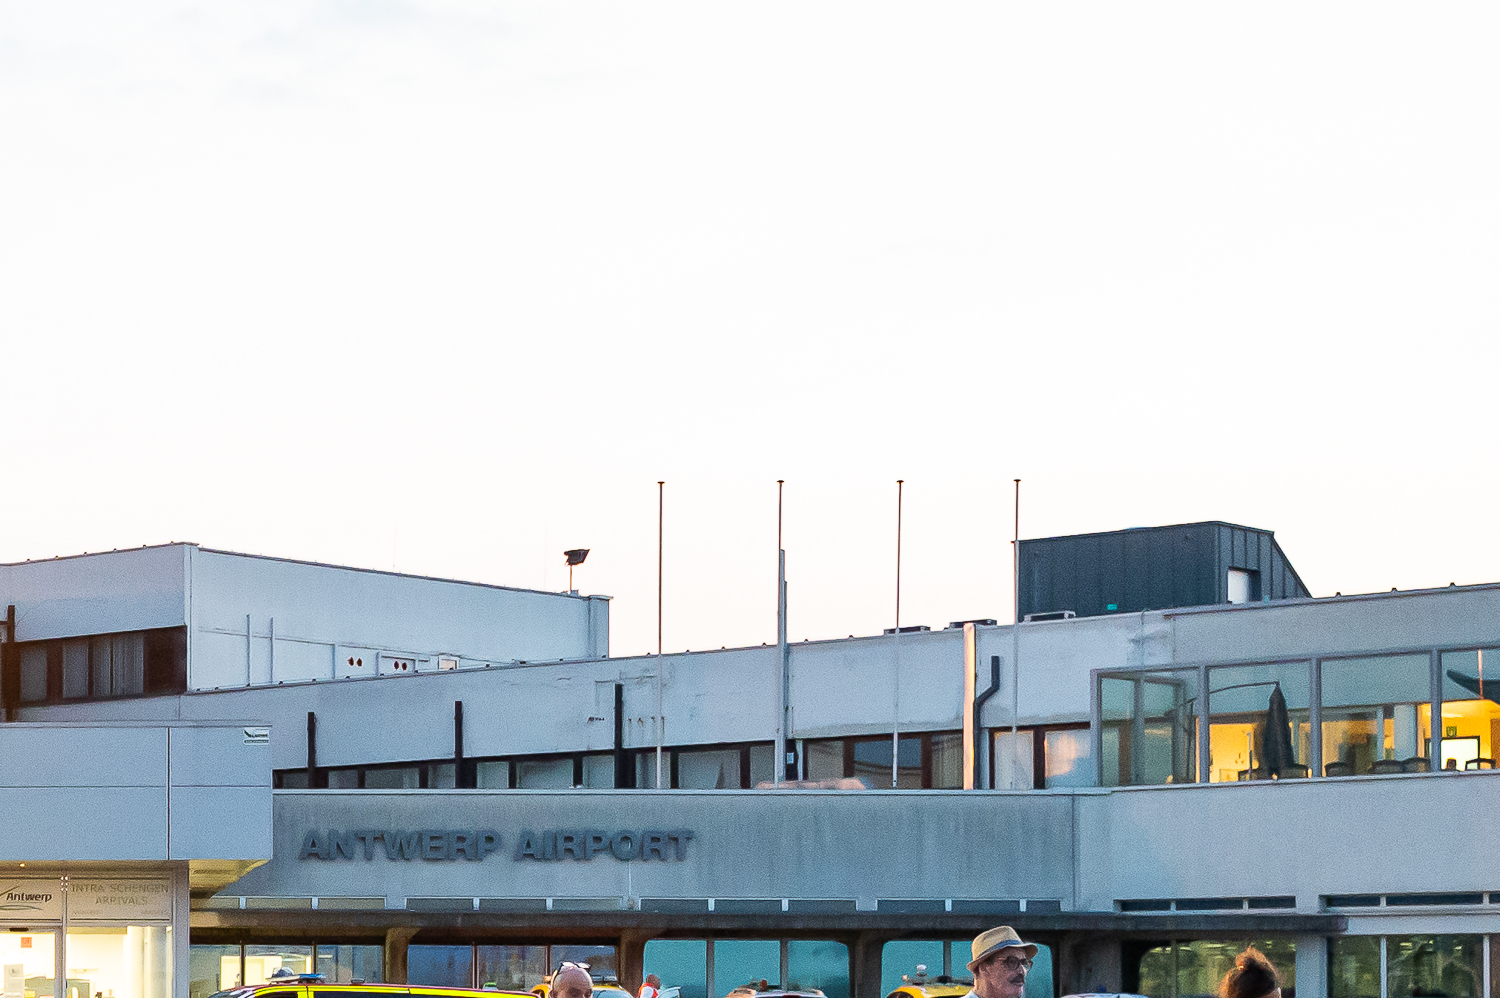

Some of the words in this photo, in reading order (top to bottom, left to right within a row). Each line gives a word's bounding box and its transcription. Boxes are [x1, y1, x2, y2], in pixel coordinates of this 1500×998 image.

[298, 829, 502, 862] ANTWERP
[513, 829, 695, 862] AIRPORT
[71, 884, 104, 893] INTRA
[110, 884, 168, 893] SCHENGEN
[6, 892, 52, 902] Antwerp
[95, 896, 148, 905] ARRIVALS
